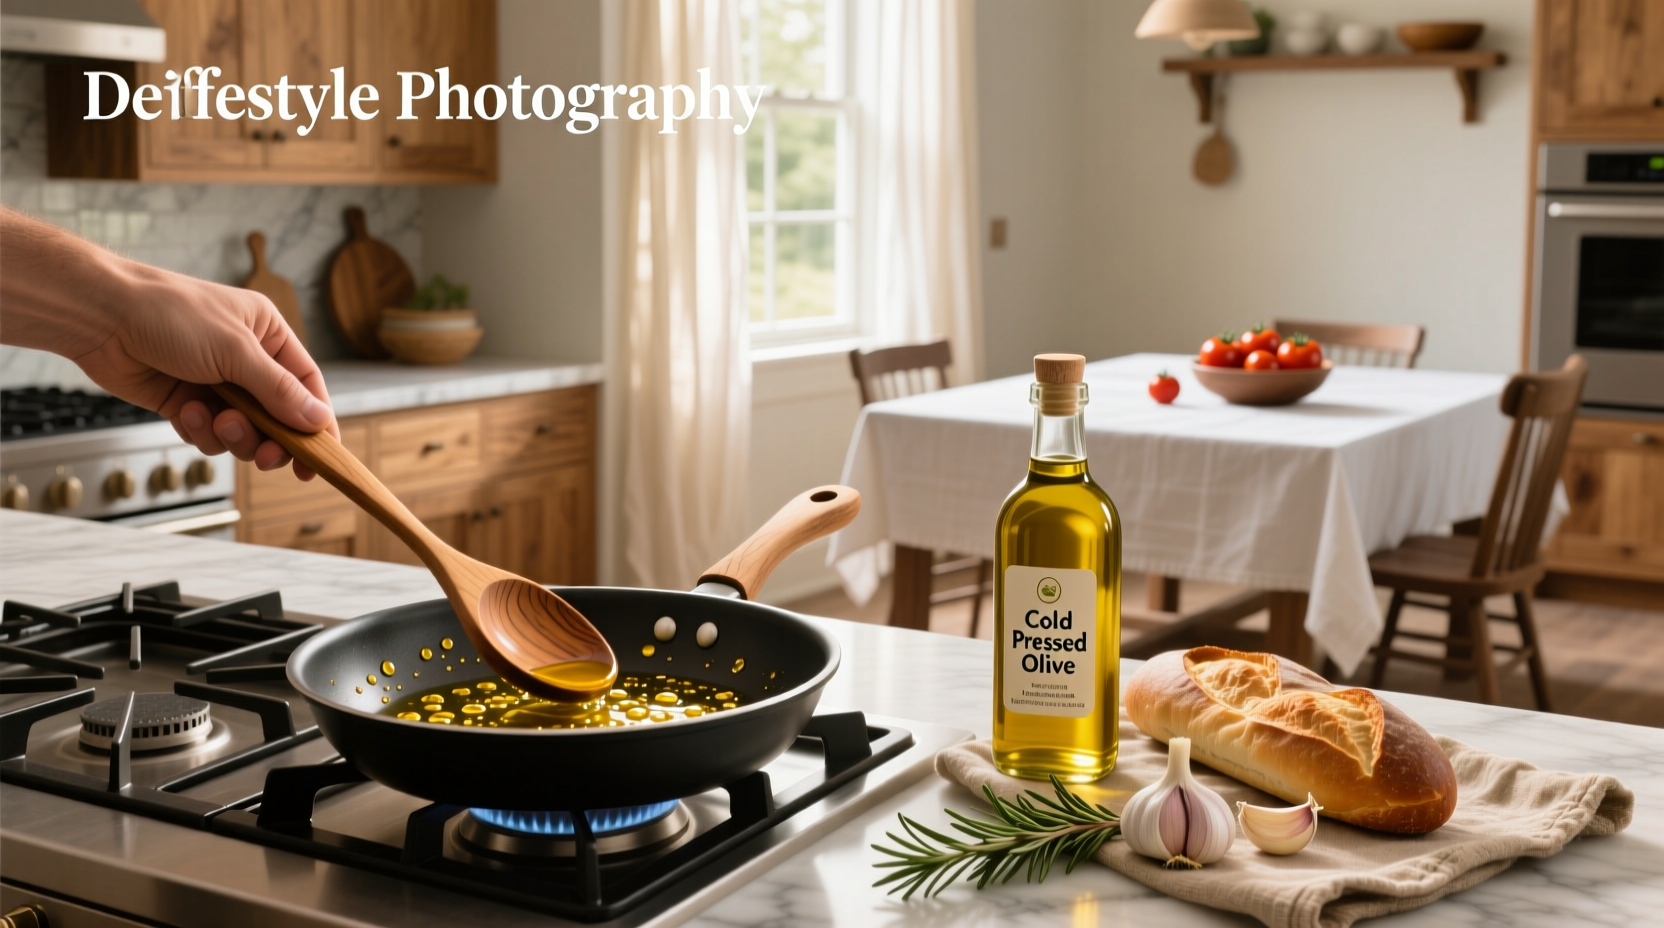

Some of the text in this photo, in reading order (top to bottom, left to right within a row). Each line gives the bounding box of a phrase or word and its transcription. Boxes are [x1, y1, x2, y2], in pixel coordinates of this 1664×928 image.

[1025, 609, 1072, 630] Cold
[1012, 629, 1087, 652] Pressed
[1021, 653, 1076, 675] Olive
